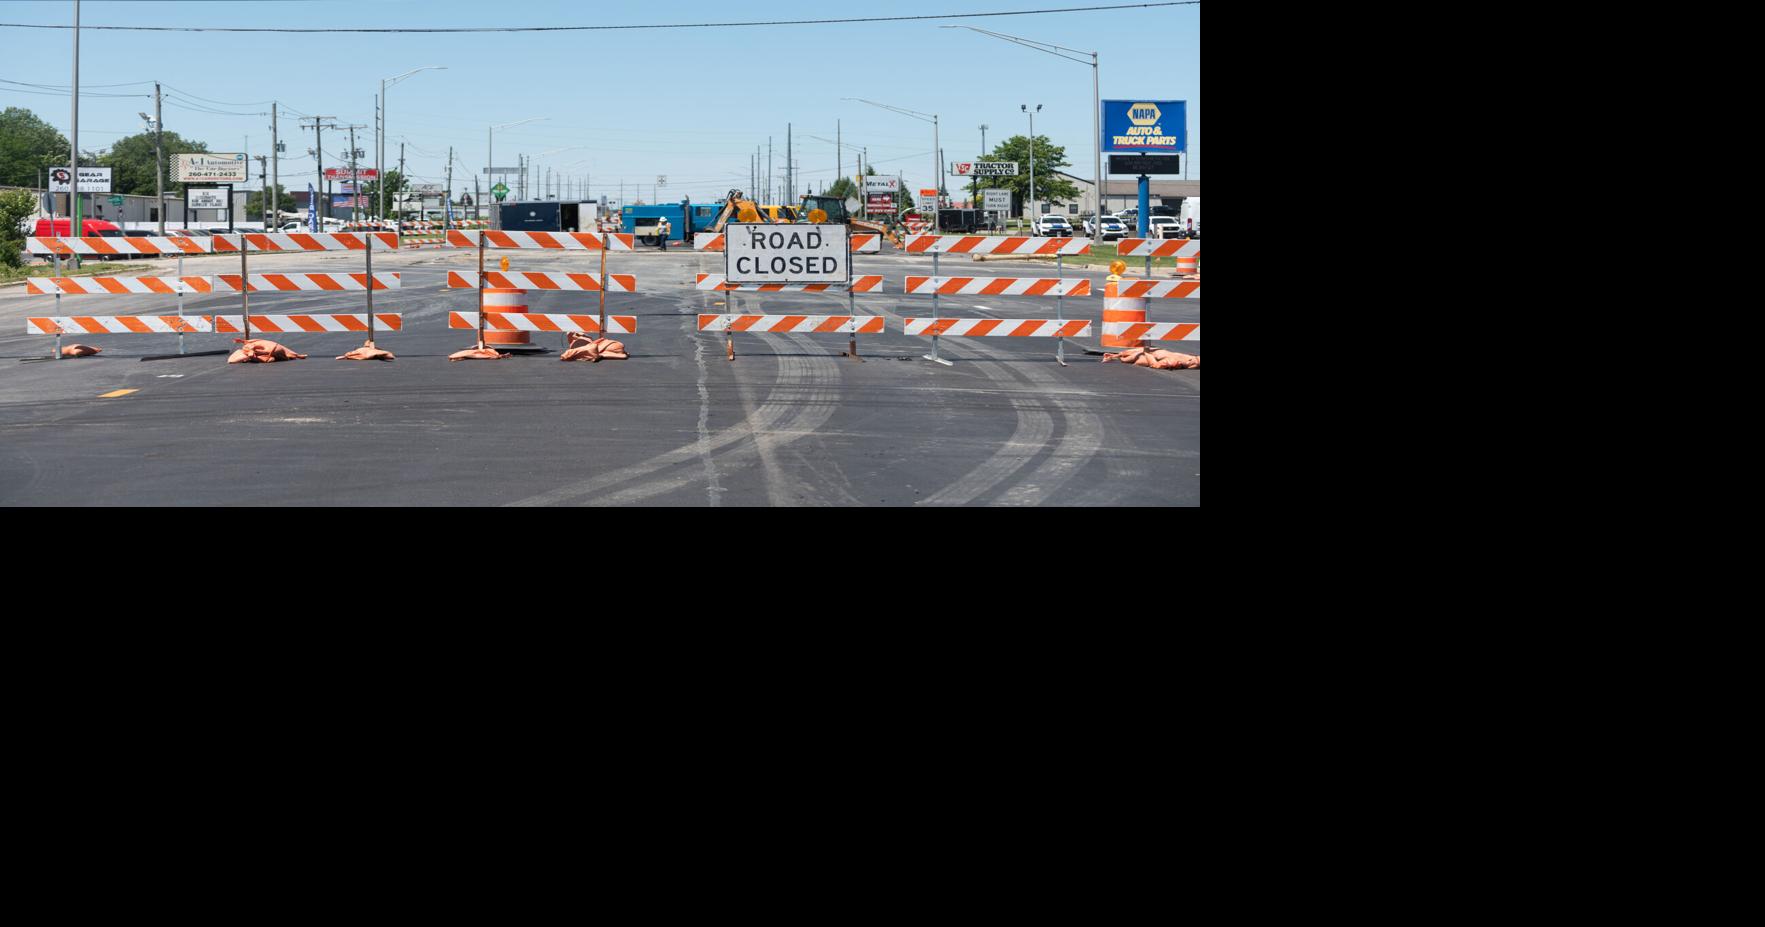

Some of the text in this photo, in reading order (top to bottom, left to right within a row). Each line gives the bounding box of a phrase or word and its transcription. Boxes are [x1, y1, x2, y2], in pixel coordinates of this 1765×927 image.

[1132, 108, 1156, 120] NAPA
[1126, 126, 1162, 136] AUTO &
[1113, 136, 1176, 145] TRUCK PARTS
[752, 232, 822, 250] ROAD
[736, 256, 838, 274] CLOSED
